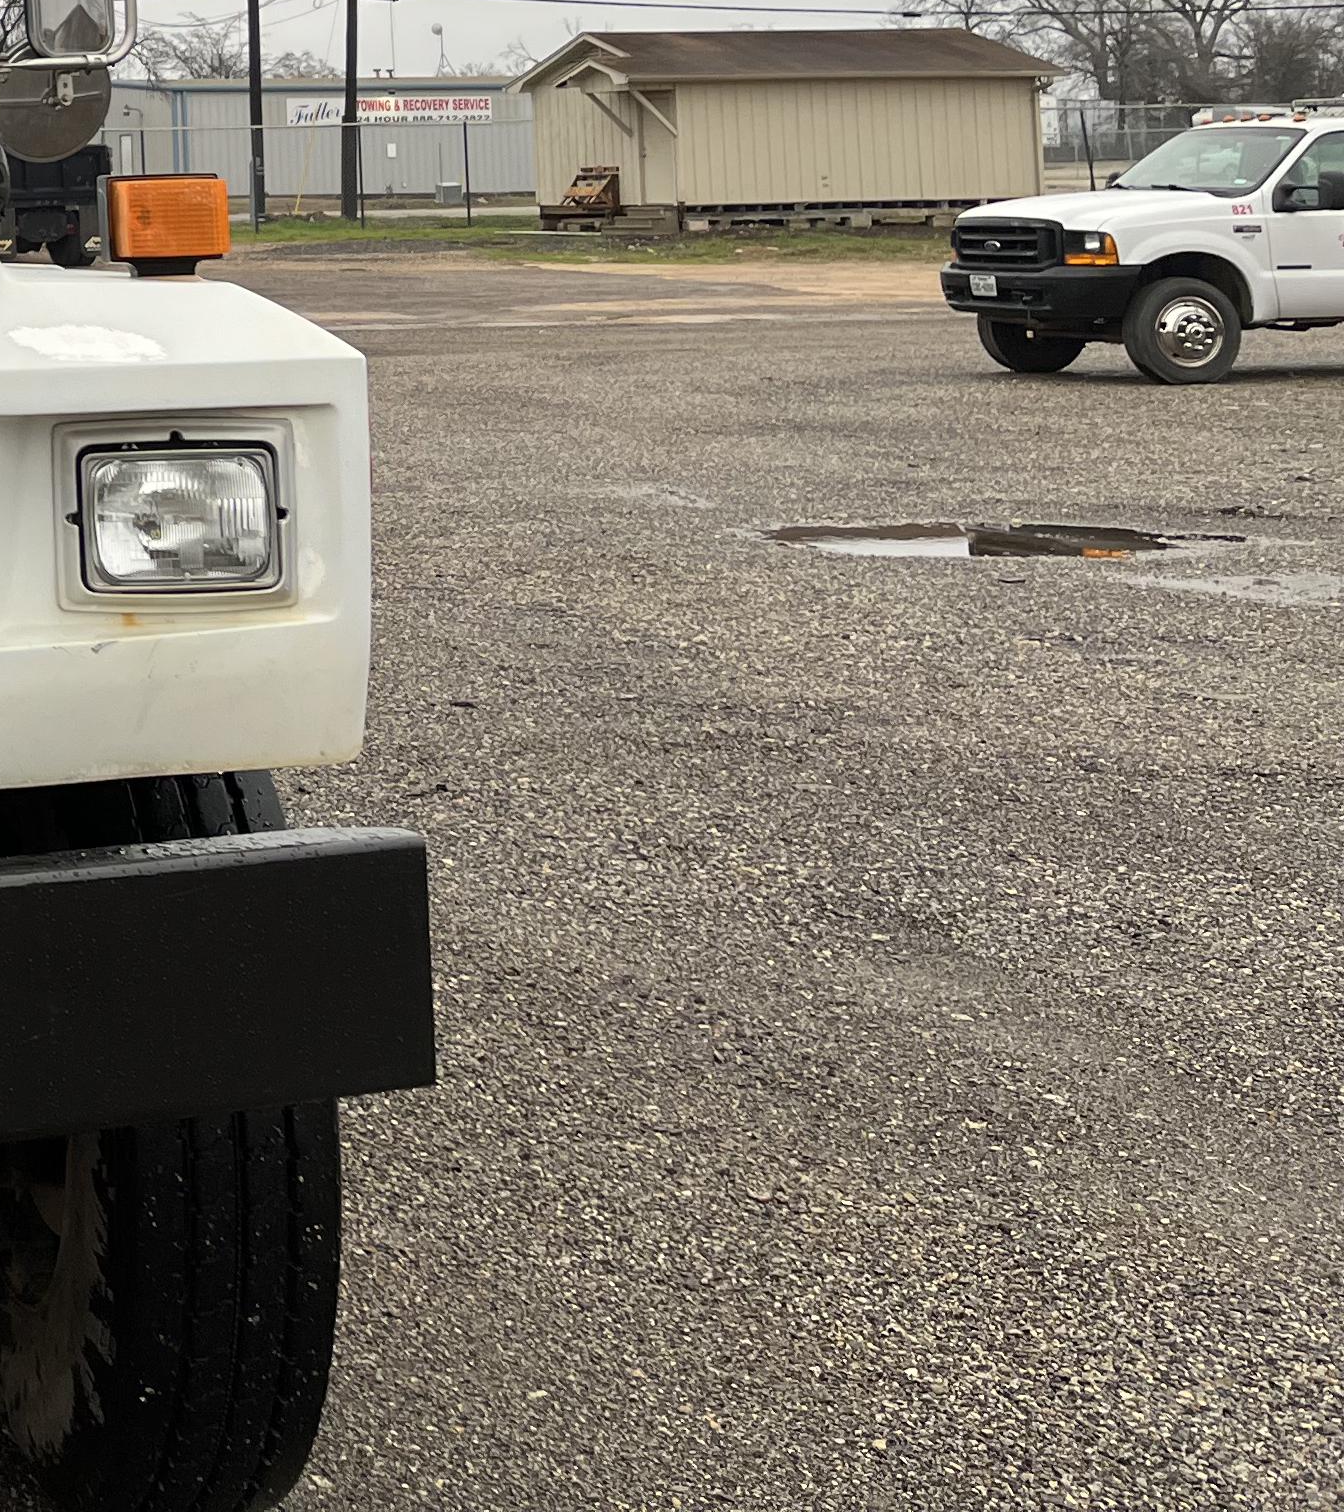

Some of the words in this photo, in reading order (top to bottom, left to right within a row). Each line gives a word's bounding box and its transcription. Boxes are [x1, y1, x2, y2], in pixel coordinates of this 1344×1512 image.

[356, 99, 391, 112] TOWING
[394, 99, 401, 111] &
[403, 99, 449, 111] RECOVERY
[452, 98, 490, 110] SERVICE
[1232, 204, 1253, 215] 821
